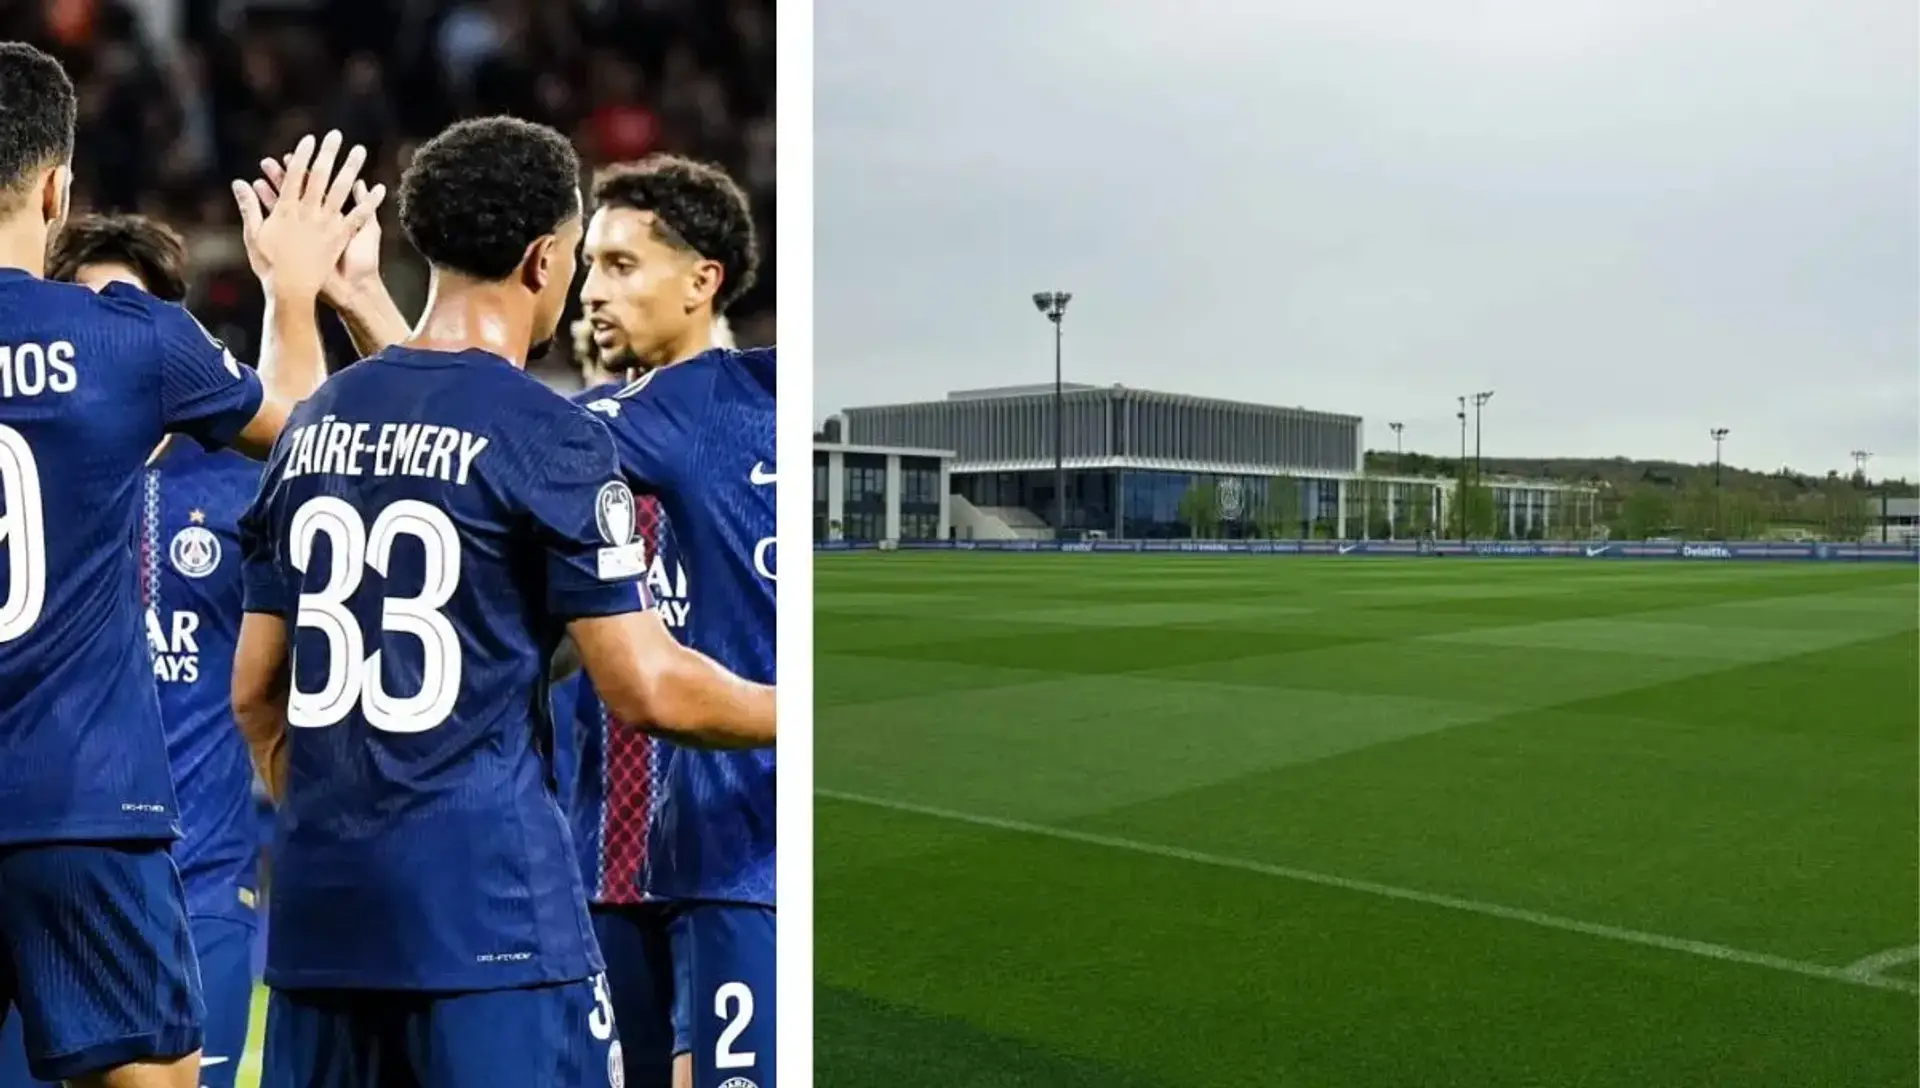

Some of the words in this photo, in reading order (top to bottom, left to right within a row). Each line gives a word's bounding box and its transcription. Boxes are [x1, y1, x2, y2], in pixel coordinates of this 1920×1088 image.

[283, 415, 488, 485] ZAÏRE-EMERY
[287, 495, 462, 733] 33
[714, 981, 757, 1069] 2
